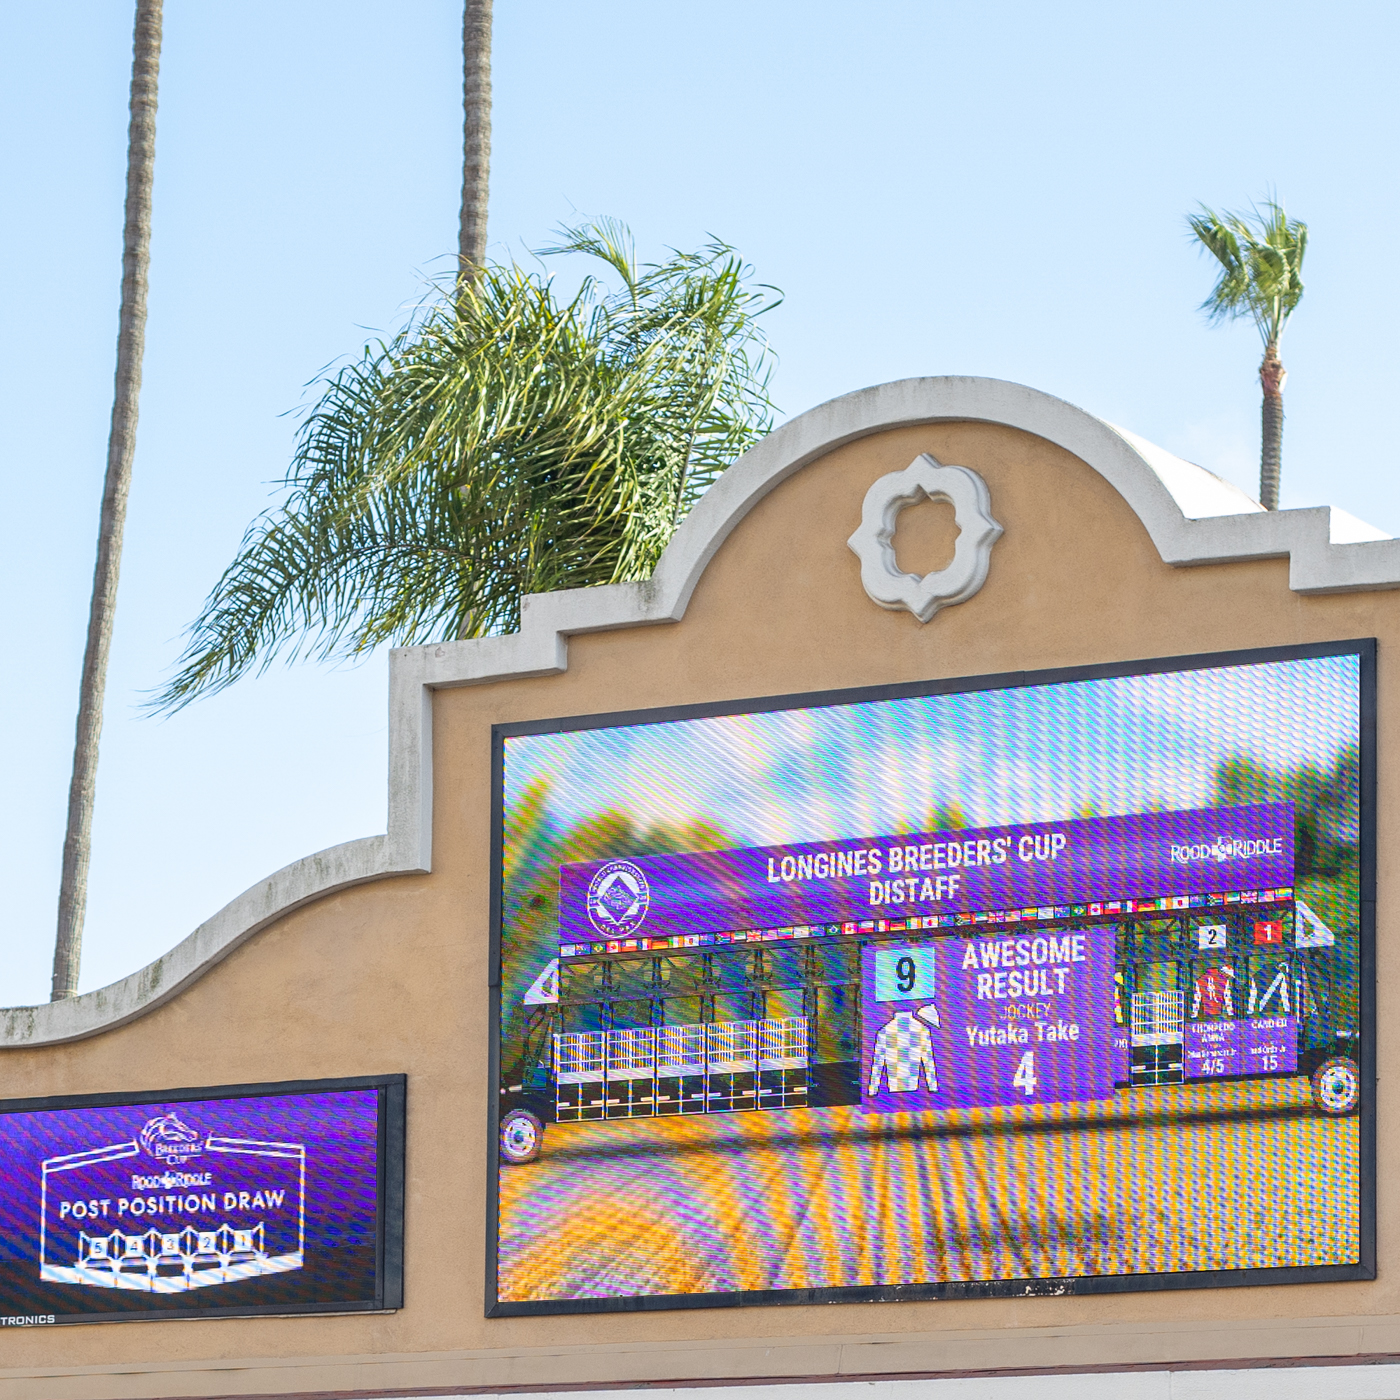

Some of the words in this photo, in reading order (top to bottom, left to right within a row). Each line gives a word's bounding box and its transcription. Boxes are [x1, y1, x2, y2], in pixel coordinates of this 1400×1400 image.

[767, 848, 882, 883] LONGINES
[887, 837, 1012, 873] BREEDERS'
[1018, 833, 1066, 862] CUP
[1170, 845, 1211, 864] ROOD
[1232, 838, 1282, 858] RIDDLE
[869, 875, 960, 905] DISTAFF
[1208, 929, 1217, 944] 2
[1263, 924, 1272, 941] 1
[962, 935, 1086, 970] AWESOME
[896, 957, 916, 992] 9
[977, 968, 1069, 1000] RESULT
[1000, 1003, 1051, 1020] JOCKEY
[966, 1023, 1029, 1047] Yutaka
[1034, 1020, 1080, 1042] Take
[1013, 1051, 1037, 1095] 4
[1201, 1058, 1225, 1074] 4/5
[1262, 1055, 1278, 1070] 15
[59, 1199, 111, 1220] POST
[118, 1193, 216, 1217] POSITION
[223, 1189, 285, 1210] DRAW
[94, 1242, 101, 1254] 5
[130, 1241, 137, 1252] 4
[203, 1236, 211, 1248] 2
